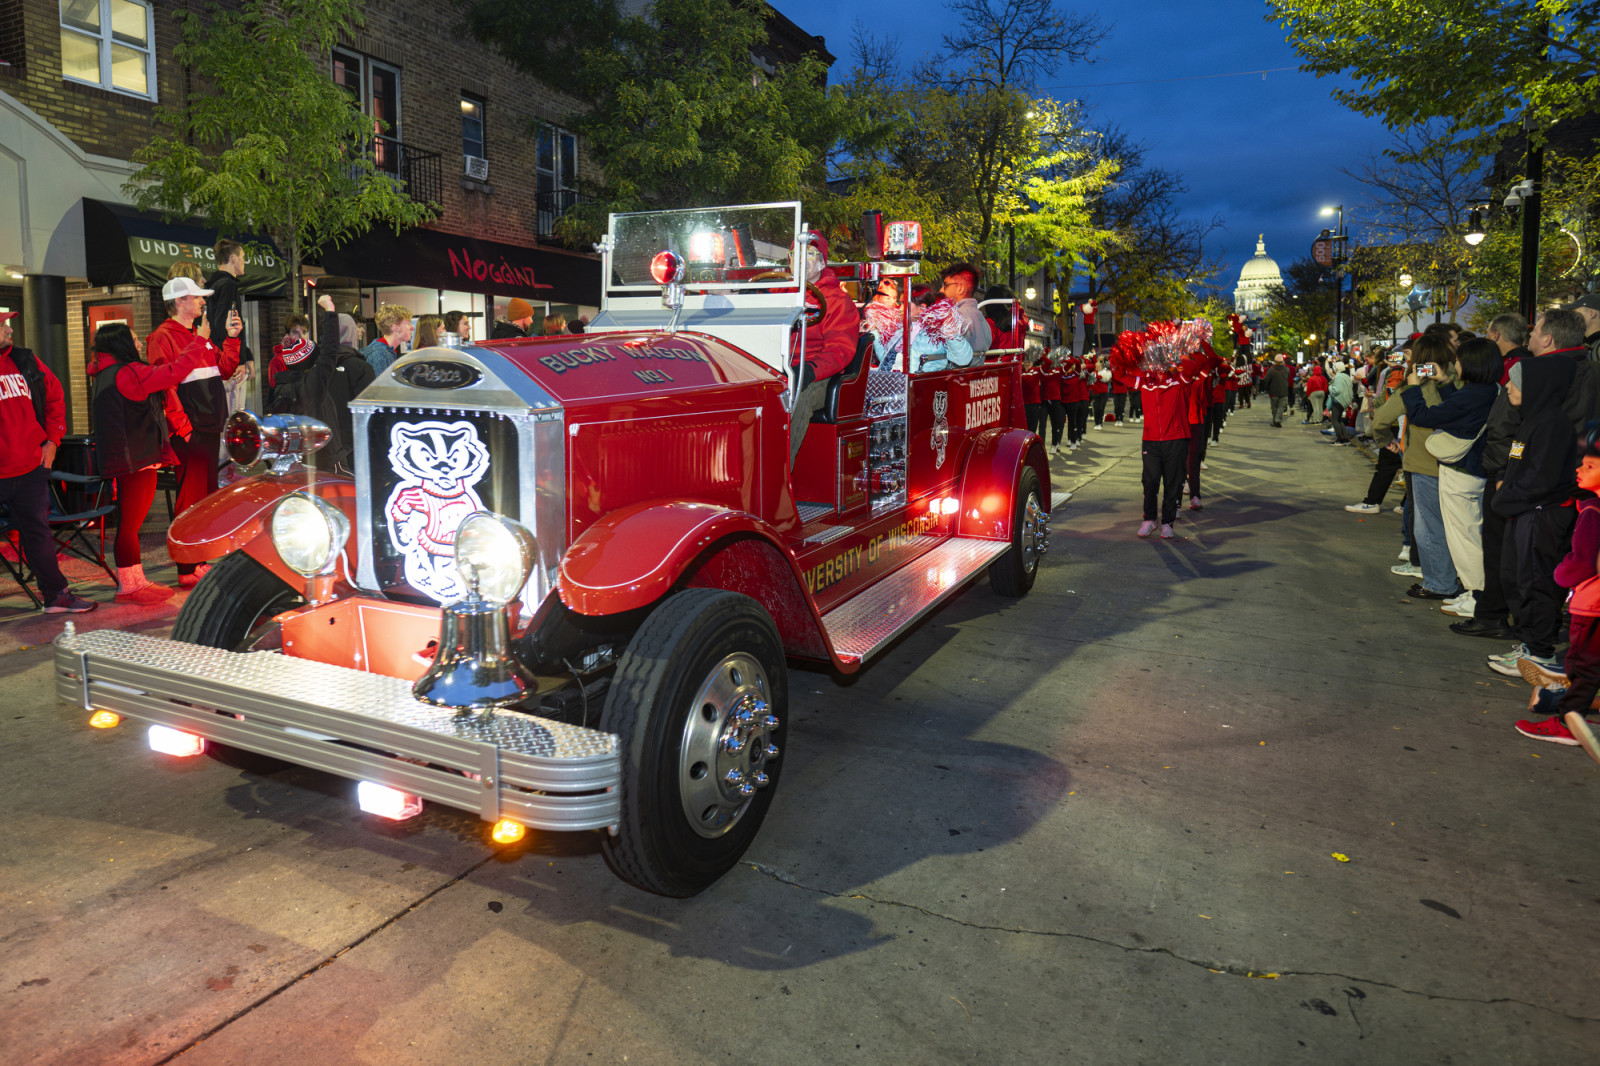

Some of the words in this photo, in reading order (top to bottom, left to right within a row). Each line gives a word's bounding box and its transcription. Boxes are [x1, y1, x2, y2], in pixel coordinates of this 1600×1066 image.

[139, 240, 275, 267] UNDERGUND
[538, 346, 617, 374] BUCKY
[616, 345, 709, 363] WAGON
[969, 376, 999, 398] WISCONSIN
[965, 396, 1001, 431] BADGERS
[868, 534, 884, 563] OF
[888, 511, 939, 552] WISCONSIN
